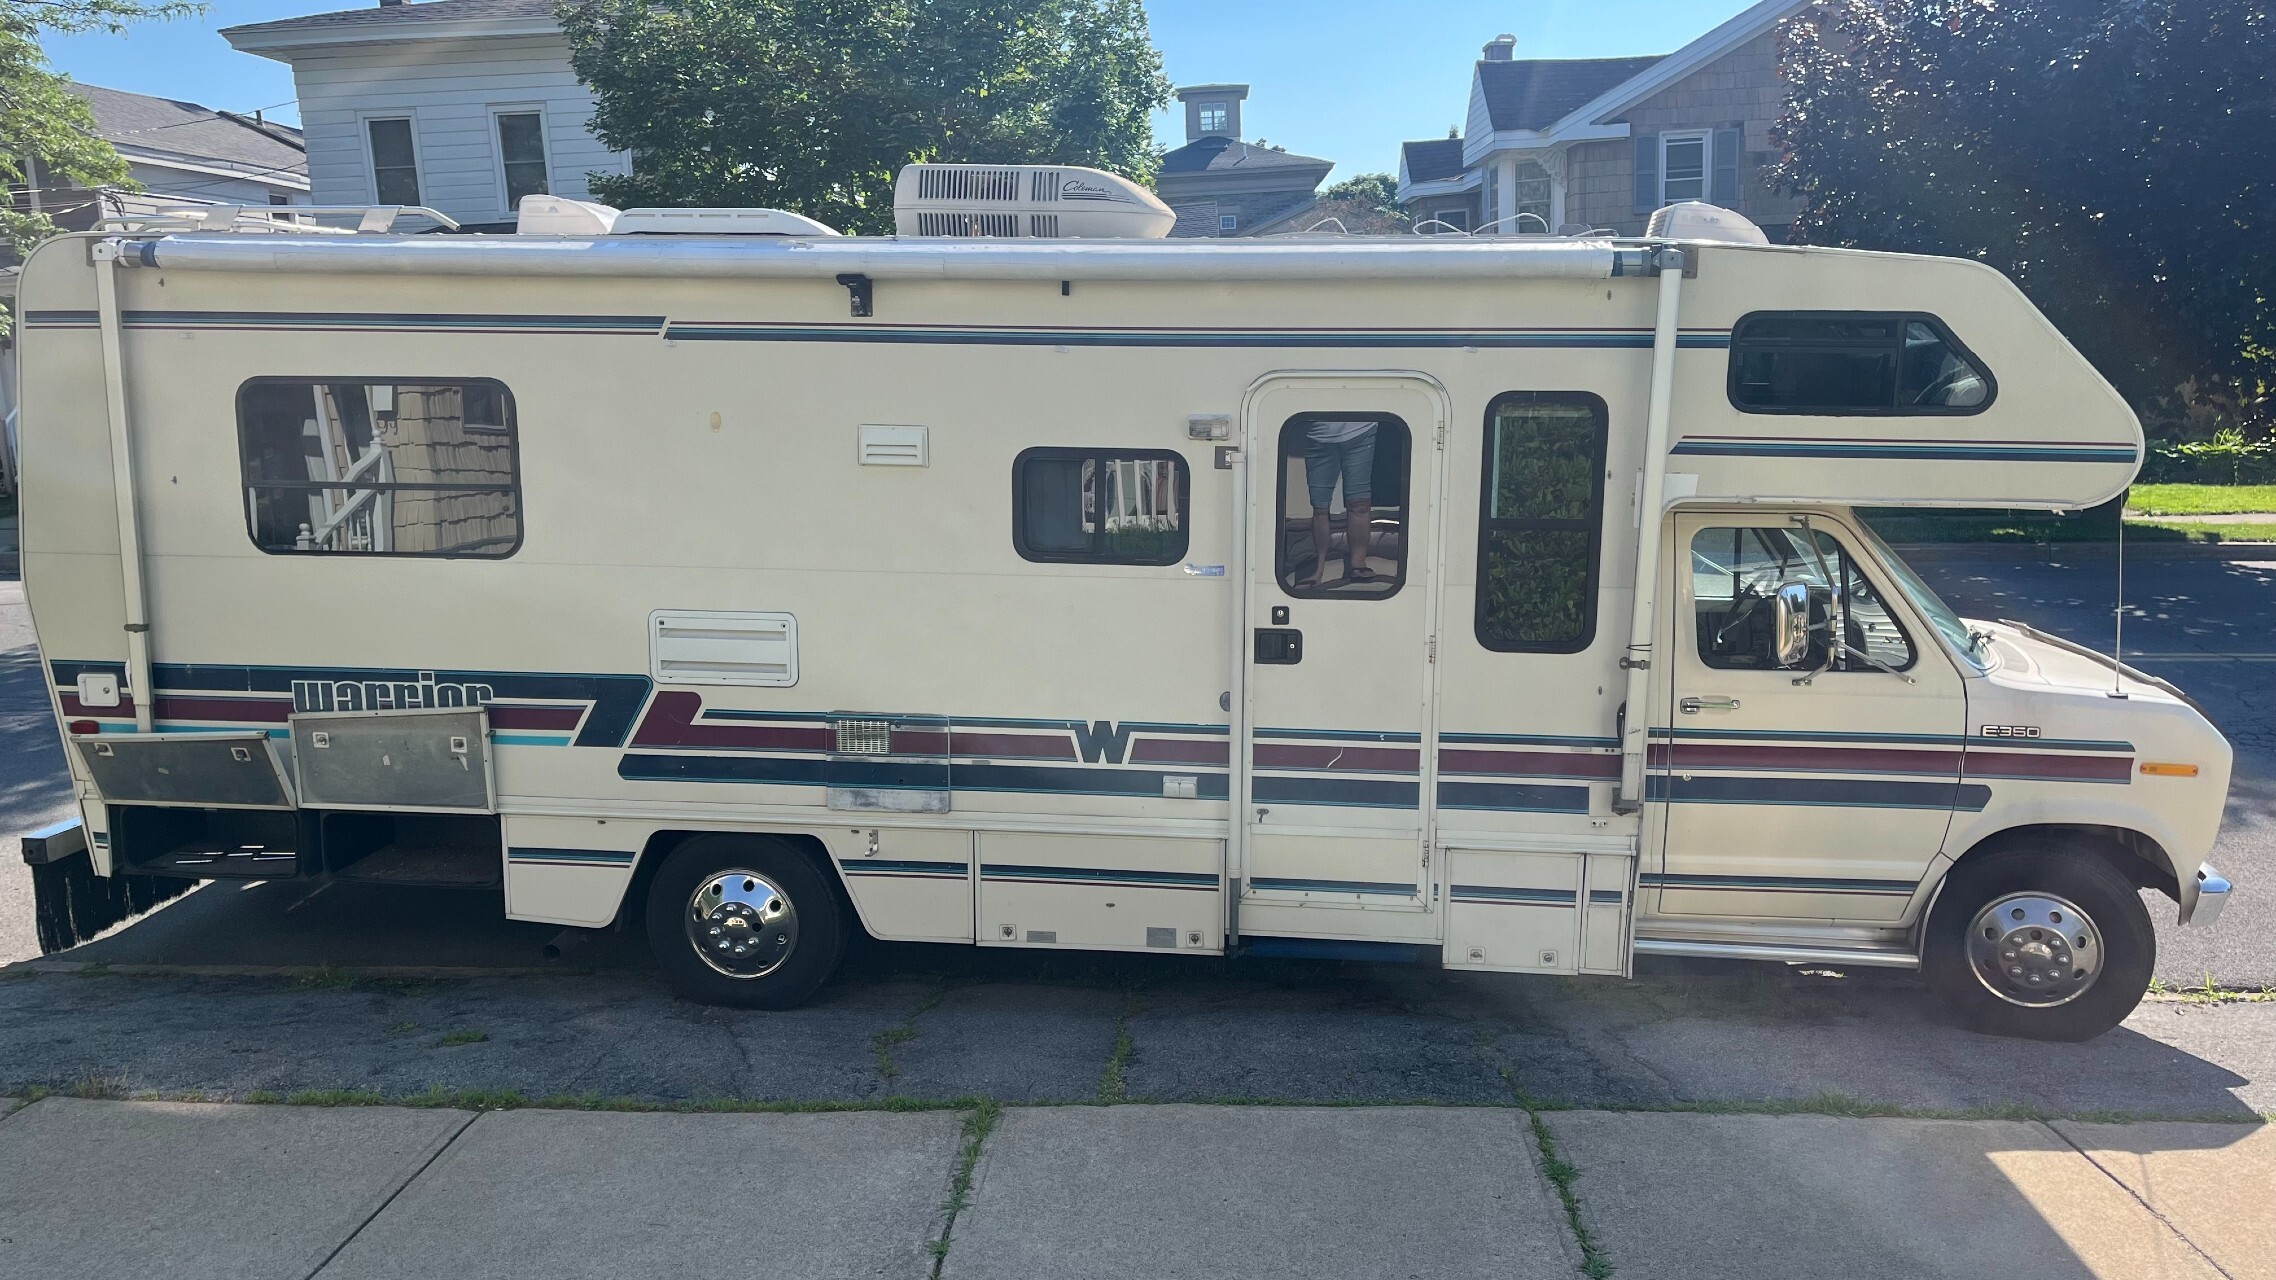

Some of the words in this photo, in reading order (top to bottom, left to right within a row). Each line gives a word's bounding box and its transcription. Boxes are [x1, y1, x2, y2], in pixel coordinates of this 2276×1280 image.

[1062, 180, 1112, 194] Coleman
[1982, 725, 2040, 738] E350
[1075, 720, 1131, 764] W
